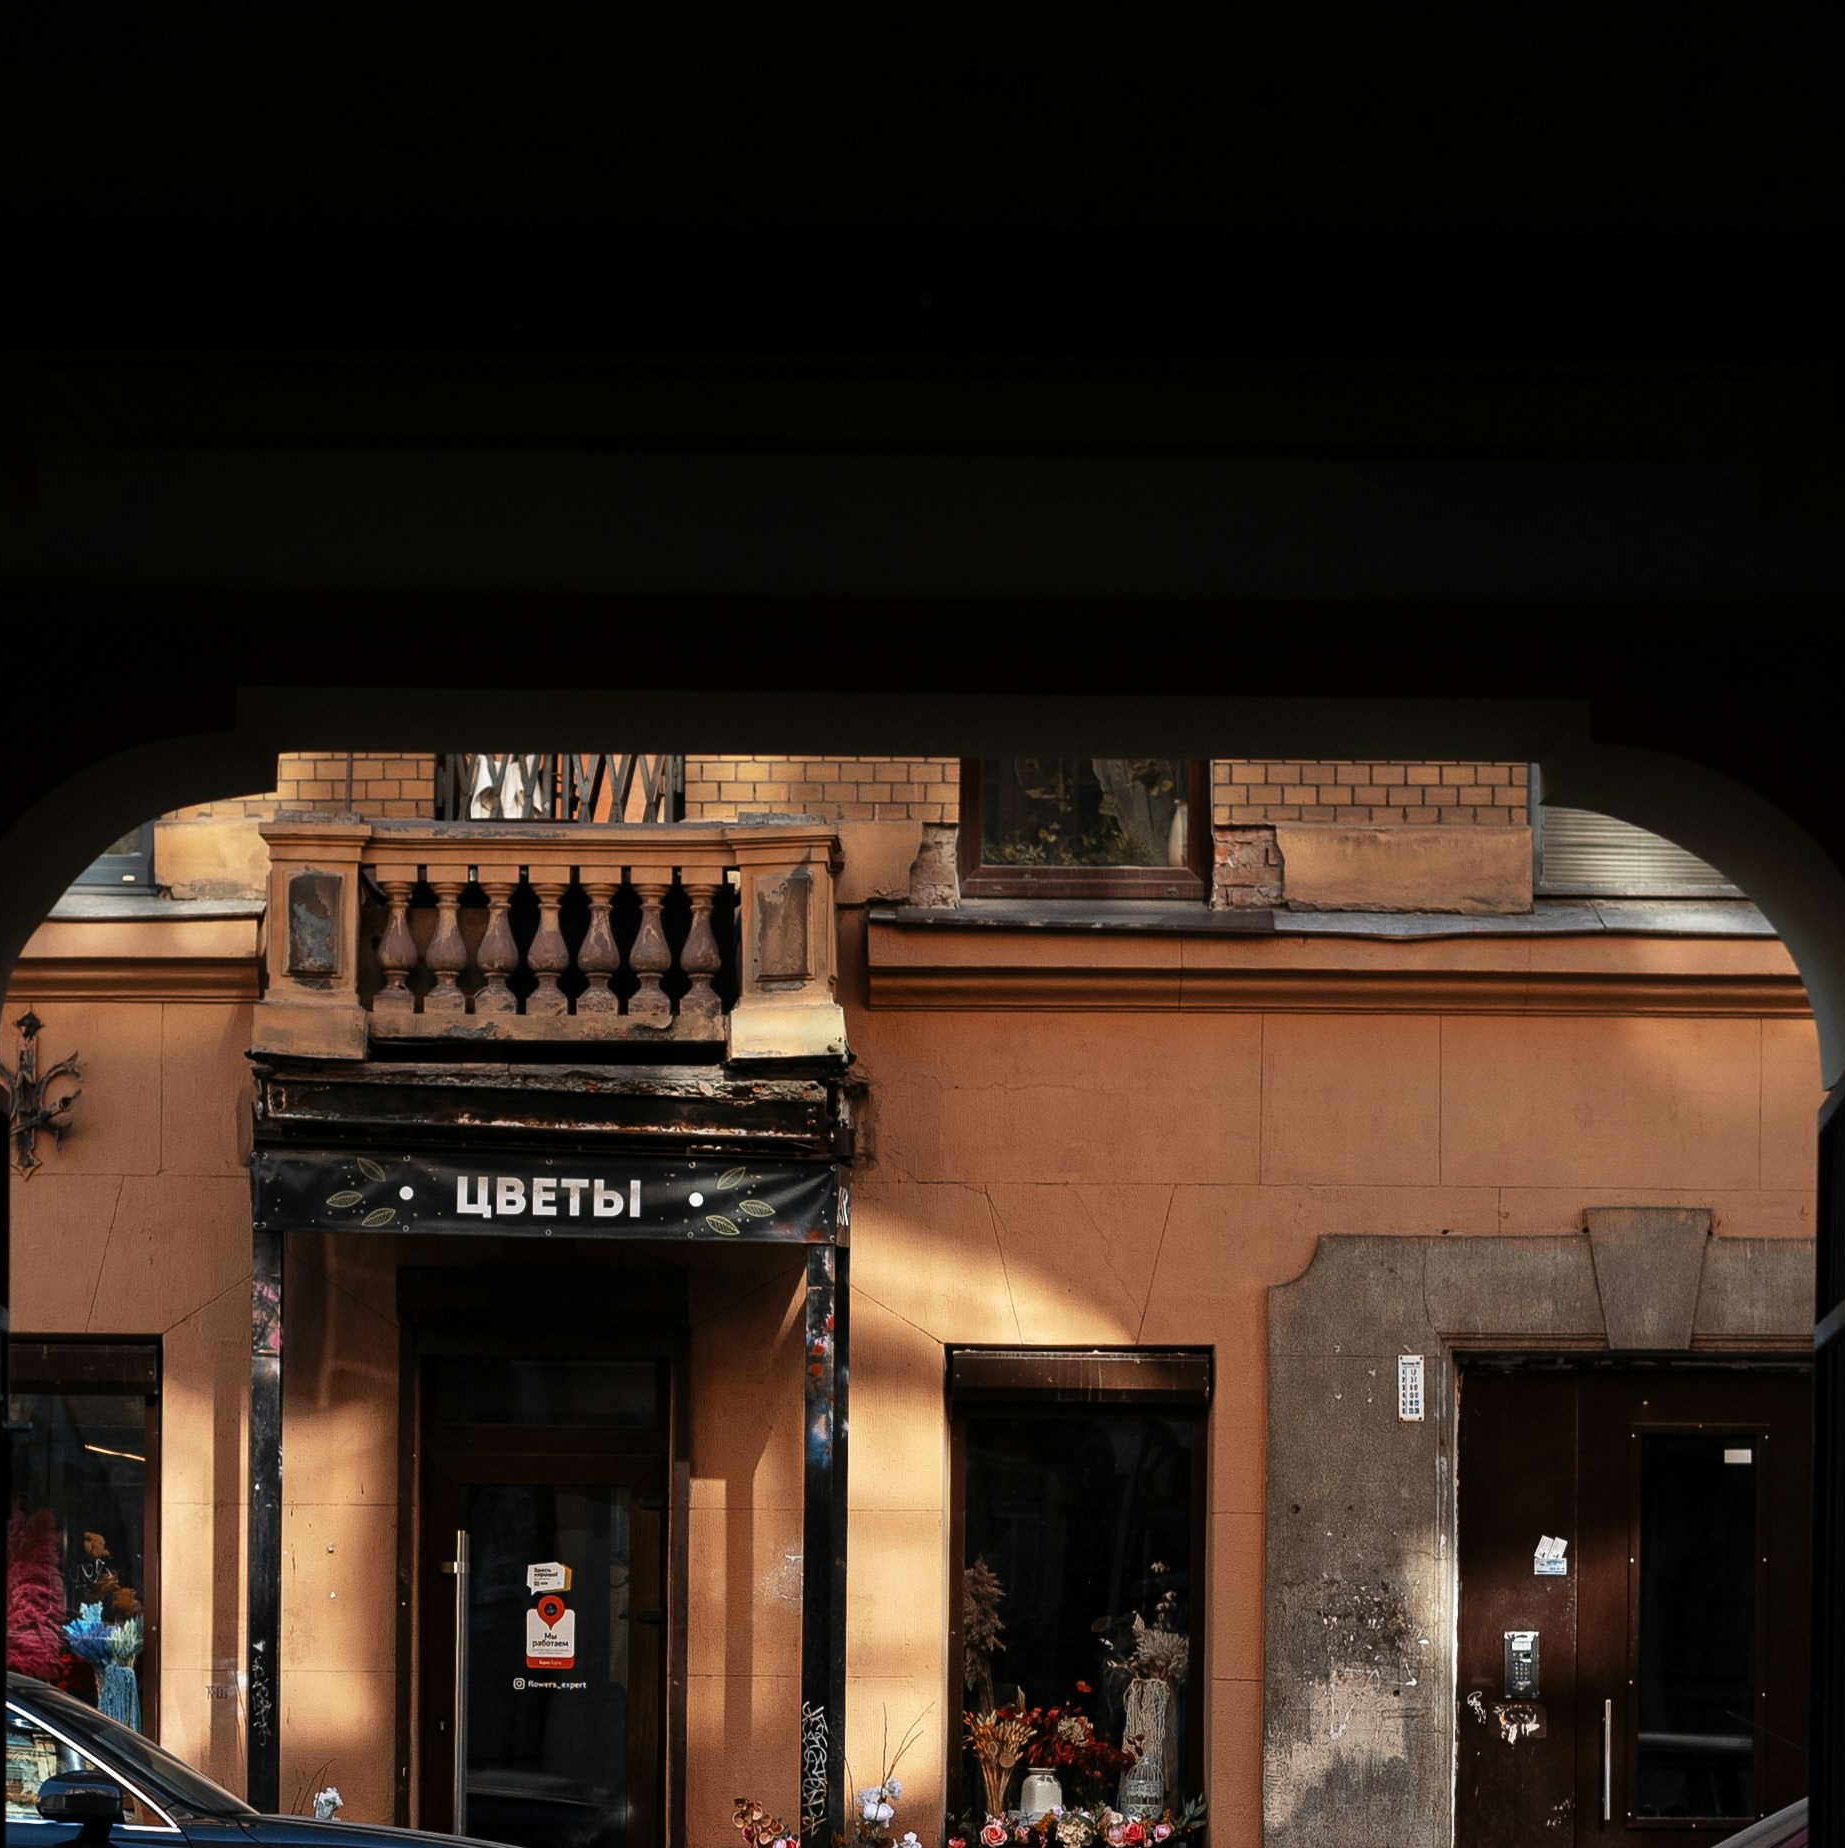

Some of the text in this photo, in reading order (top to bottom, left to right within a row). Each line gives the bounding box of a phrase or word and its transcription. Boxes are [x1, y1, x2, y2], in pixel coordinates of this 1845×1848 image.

[456, 1175, 642, 1219] ЦВЕТЫ
[544, 1632, 557, 1640] Мы
[528, 1679, 587, 1690] flowers_expert
